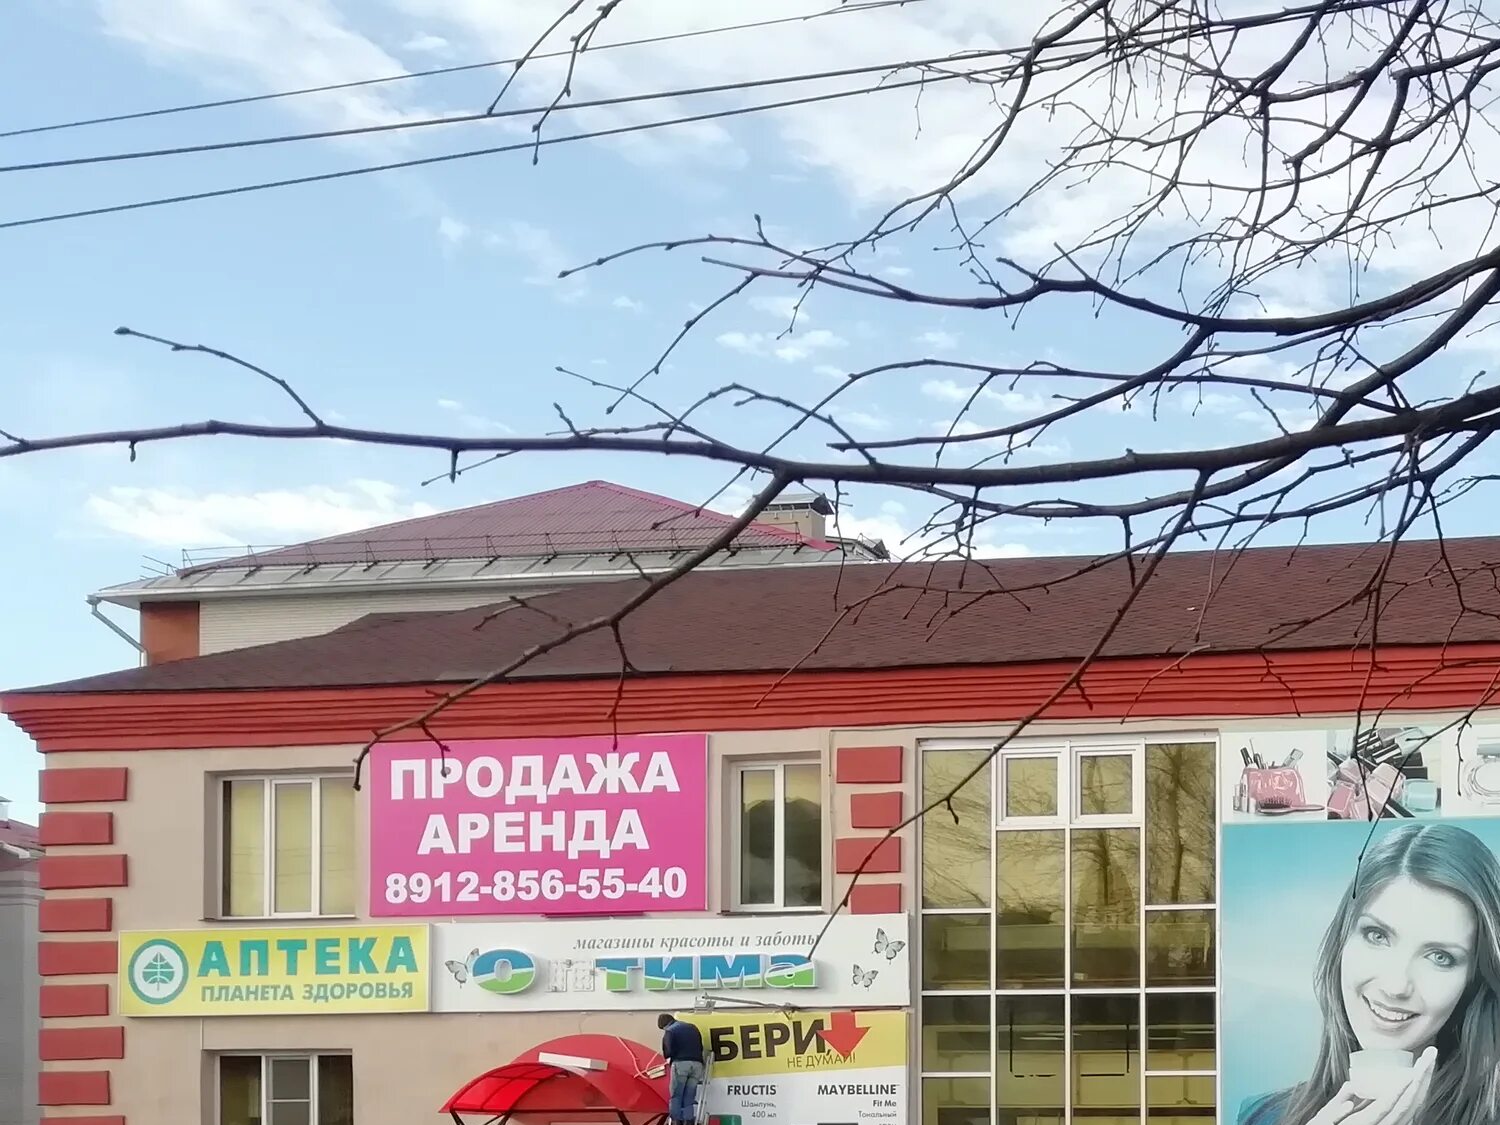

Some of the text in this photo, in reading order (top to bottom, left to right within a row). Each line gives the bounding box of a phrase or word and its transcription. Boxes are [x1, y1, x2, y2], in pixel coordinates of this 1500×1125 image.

[390, 751, 681, 805] ПРОДАЖА
[416, 809, 650, 859] АРЕНДА
[385, 866, 687, 904] 8912-856-55-40
[572, 929, 821, 952] магазины красоты и заботы
[197, 935, 419, 977] АПТЕКА
[201, 982, 414, 1003] ПЛАНЕТА ЗДОРОВЬЯ
[787, 1056, 803, 1068] НЕ
[727, 1085, 777, 1096] FRUCTIS
[817, 1084, 897, 1095] MAYBELLINE
